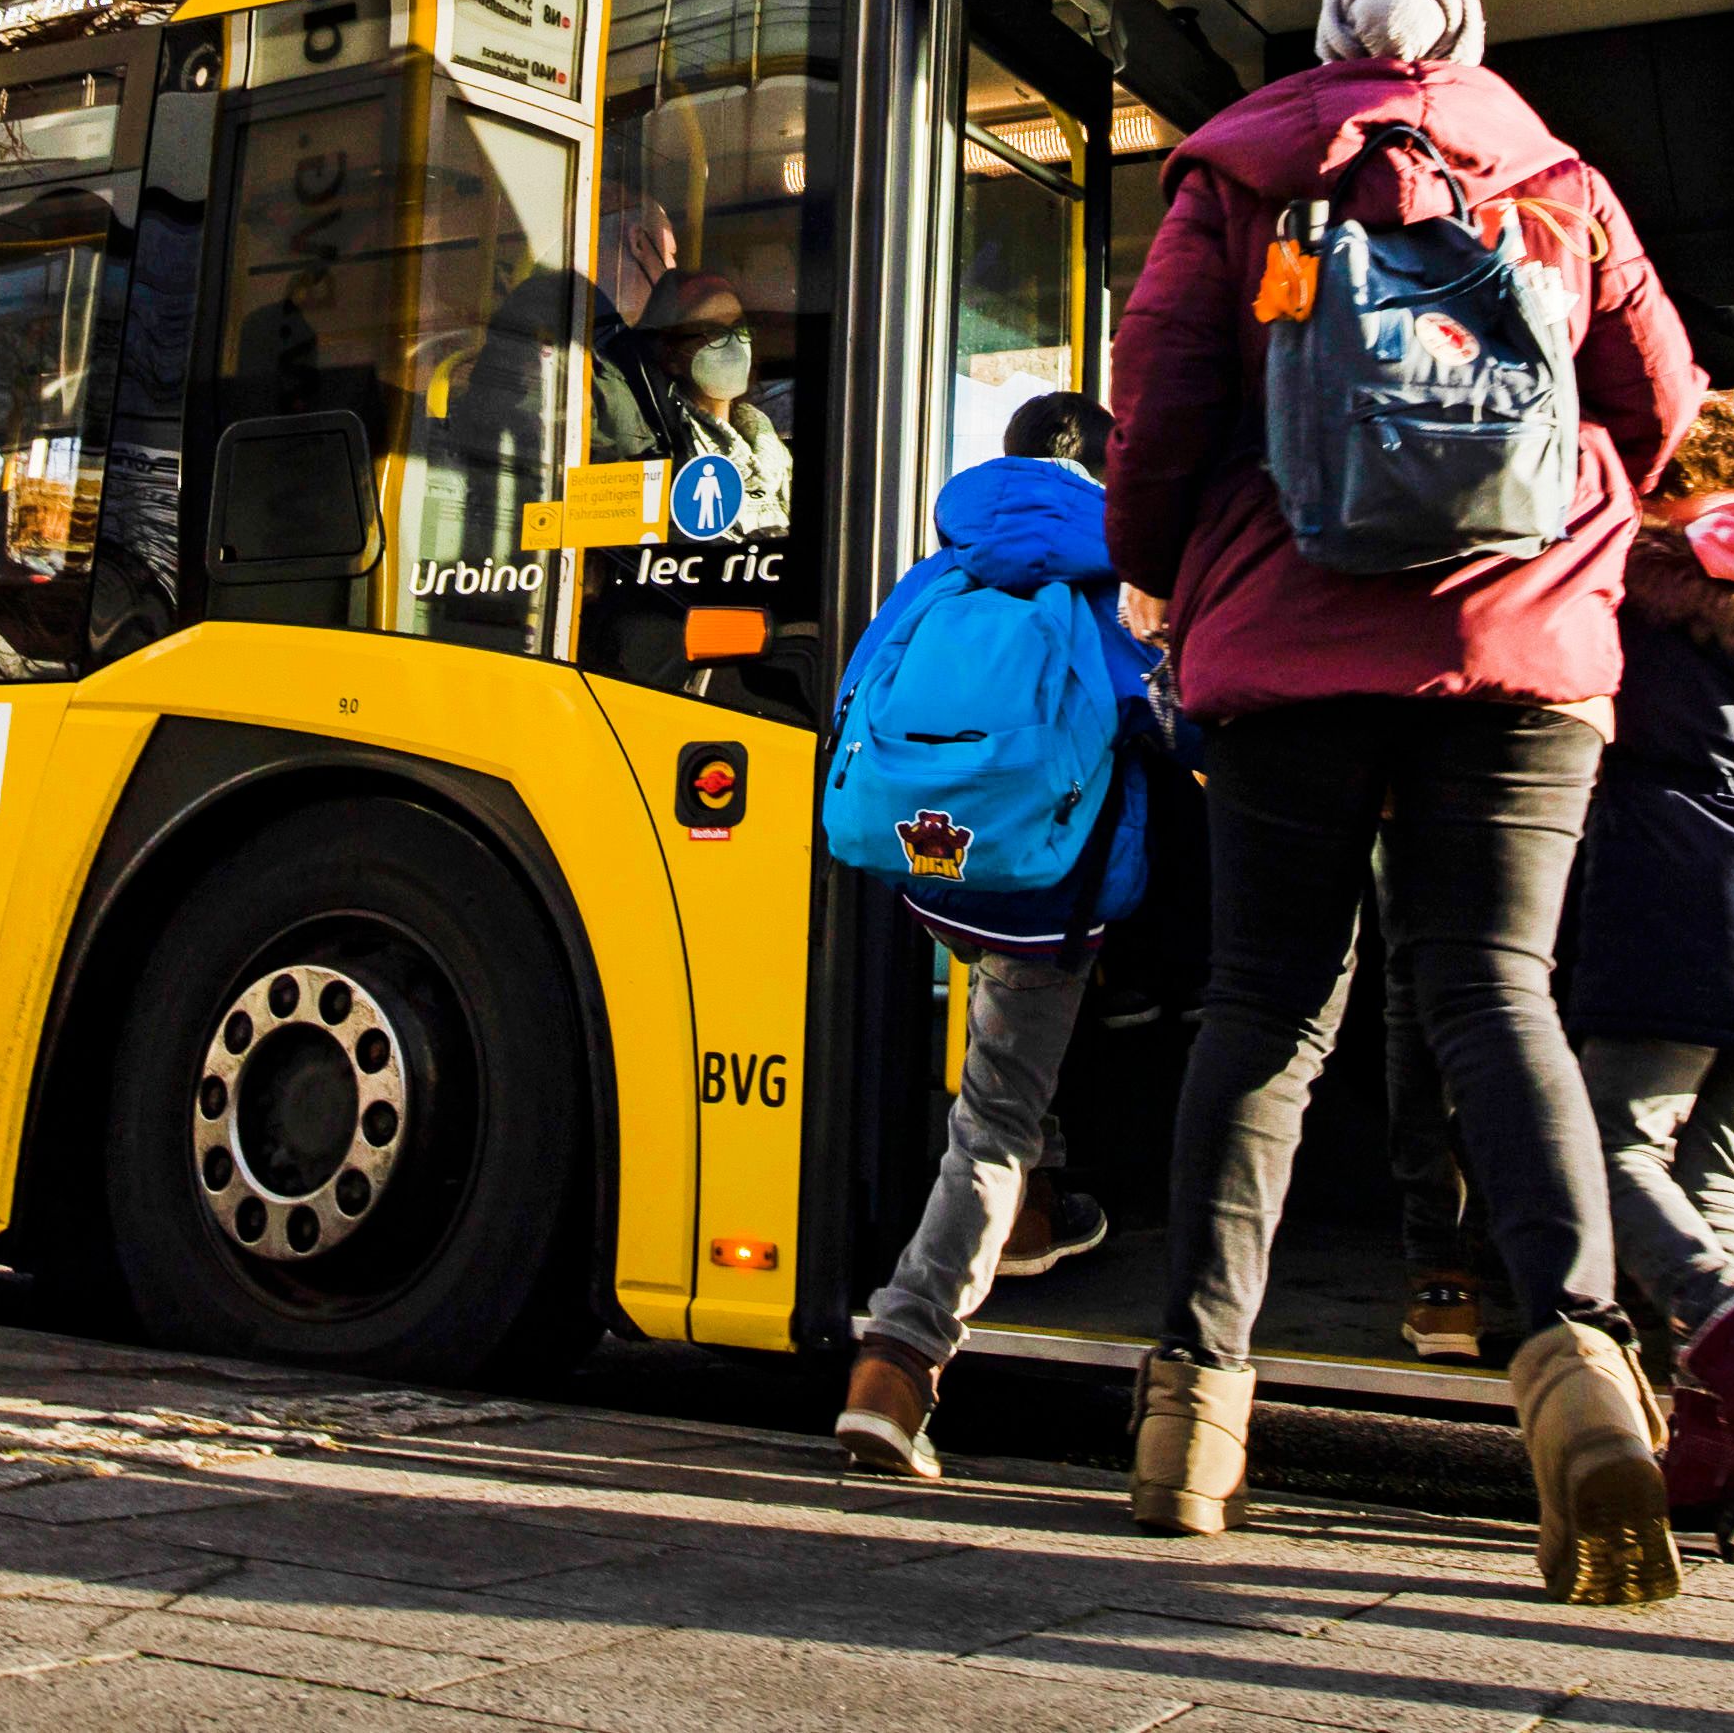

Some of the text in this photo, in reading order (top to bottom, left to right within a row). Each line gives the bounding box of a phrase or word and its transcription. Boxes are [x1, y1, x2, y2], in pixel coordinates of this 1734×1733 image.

[571, 471, 662, 486] Beförderung nur
[570, 489, 641, 505] mit gültigem
[569, 507, 636, 520] Fahrausweis
[408, 557, 544, 596] Urbino
[701, 1052, 788, 1108] BVG
